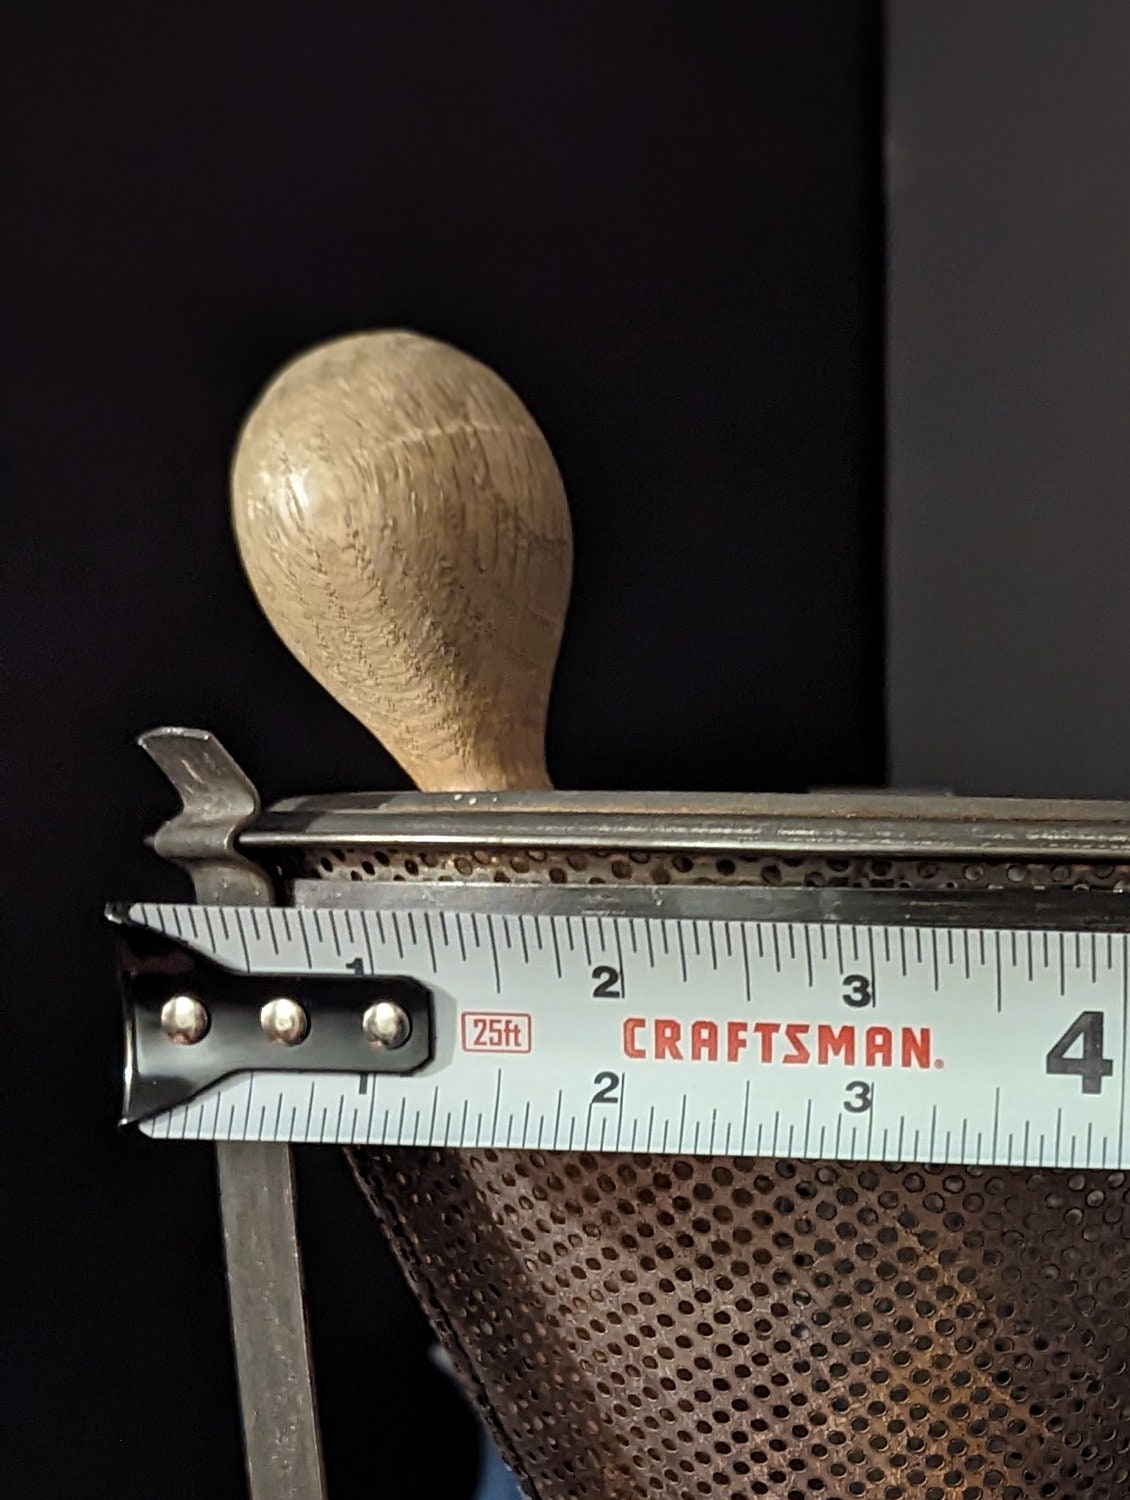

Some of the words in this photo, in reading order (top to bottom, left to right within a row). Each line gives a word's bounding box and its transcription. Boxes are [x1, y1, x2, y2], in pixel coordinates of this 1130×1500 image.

[591, 965, 620, 998] 2
[842, 975, 873, 1008] 3
[472, 1018, 522, 1048] 25ft
[1046, 1011, 1114, 1094] 4
[592, 1071, 620, 1103] 2
[843, 1081, 873, 1114] 3
